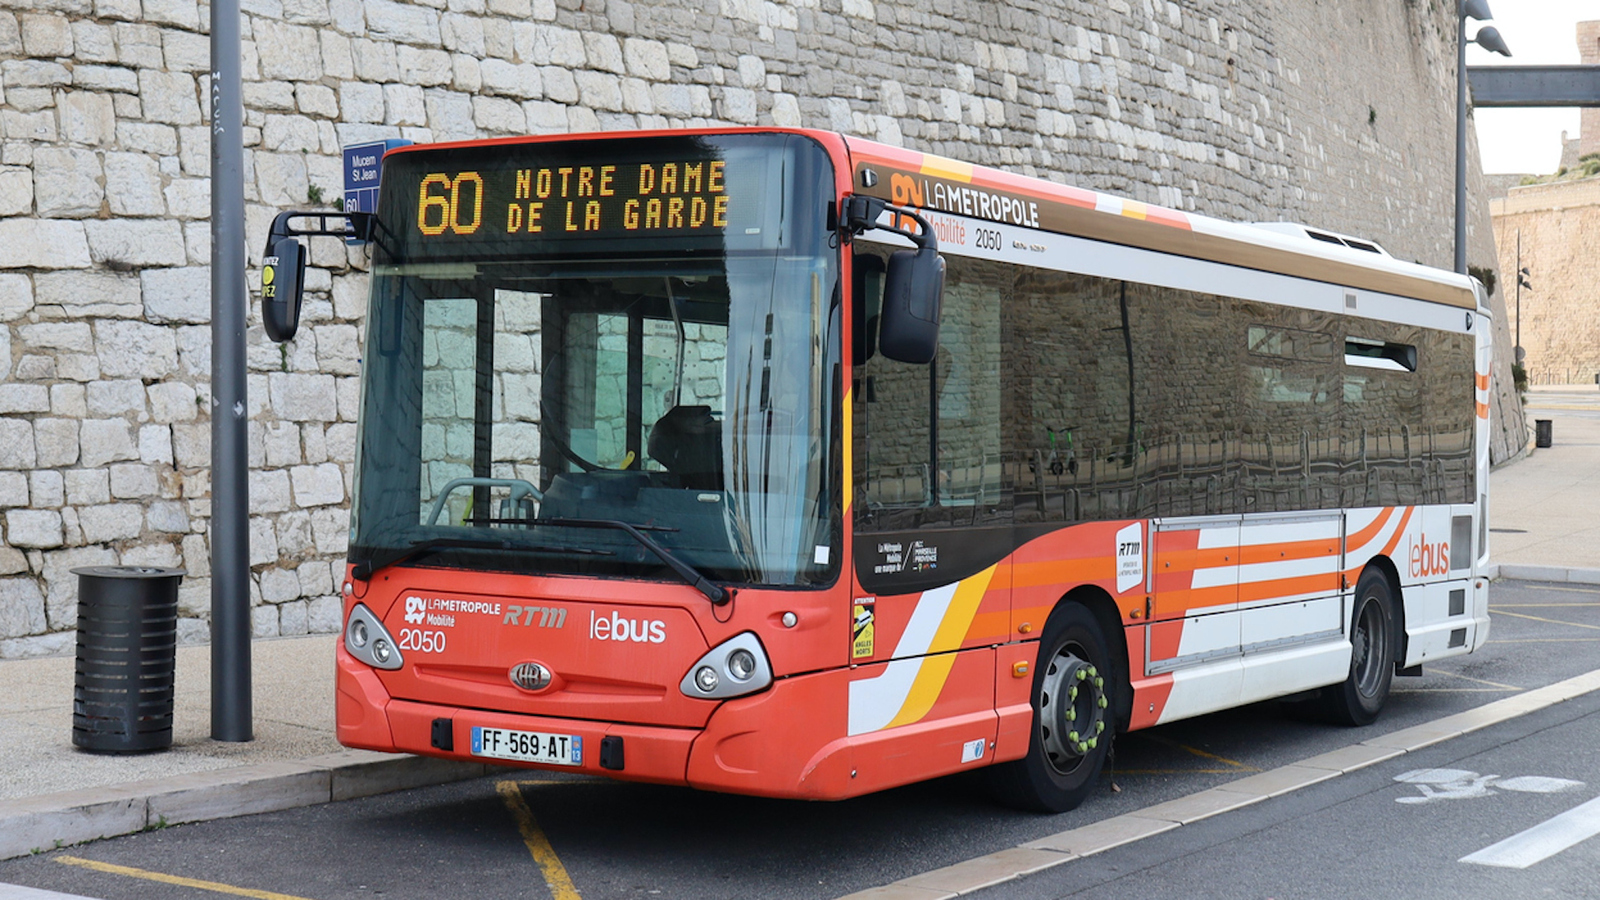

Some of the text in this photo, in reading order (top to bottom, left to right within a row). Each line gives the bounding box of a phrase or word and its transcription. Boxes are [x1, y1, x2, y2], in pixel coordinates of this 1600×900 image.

[352, 155, 376, 168] Mucem
[352, 168, 377, 181] St Jean
[515, 160, 726, 199] NOTRE DAME
[346, 198, 357, 213] 60
[417, 171, 484, 235] 60
[506, 195, 729, 233] DE LA GARDE
[975, 228, 1002, 251] 2050
[1408, 532, 1449, 578] lebus
[427, 613, 455, 627] Mobilité
[503, 605, 567, 628] RTM
[590, 610, 666, 643] lebus
[399, 628, 446, 653] 2050
[572, 750, 581, 760] 13
